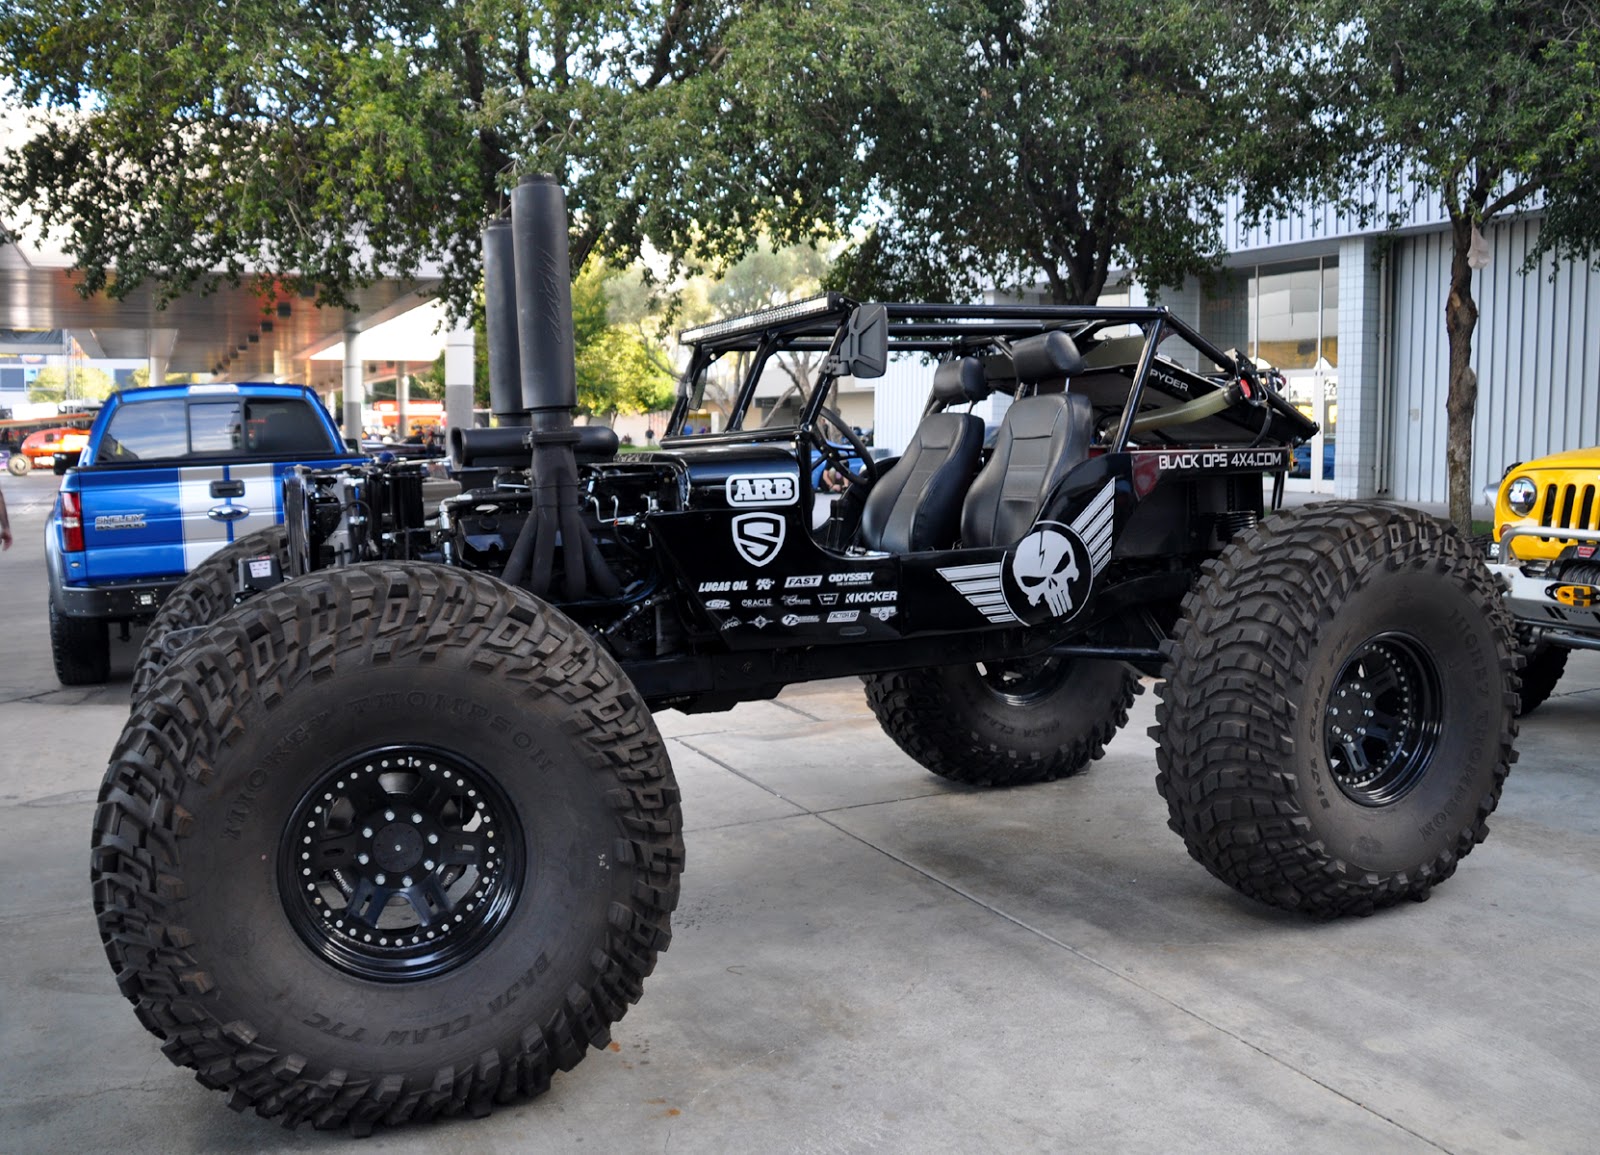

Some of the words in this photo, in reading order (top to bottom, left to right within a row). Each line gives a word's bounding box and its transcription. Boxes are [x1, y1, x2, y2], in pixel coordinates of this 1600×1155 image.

[1149, 368, 1189, 392] PYDER
[1158, 454, 1200, 470] BLACK
[1202, 453, 1228, 468] OPS
[1231, 452, 1282, 467] 4X4.COM
[734, 478, 793, 501] ARB
[95, 513, 145, 525] SHELBY
[788, 576, 819, 587] FAST
[828, 571, 874, 583] ODYSSEY
[698, 581, 731, 593] LUCAS
[732, 580, 748, 592] OIL
[741, 598, 773, 608] ORACLE
[854, 591, 898, 603] KICKER
[346, 690, 558, 776] THOMPSON
[487, 950, 552, 1016] BAJA
[302, 1011, 367, 1043] TTC
[380, 1013, 474, 1047] CLAW
